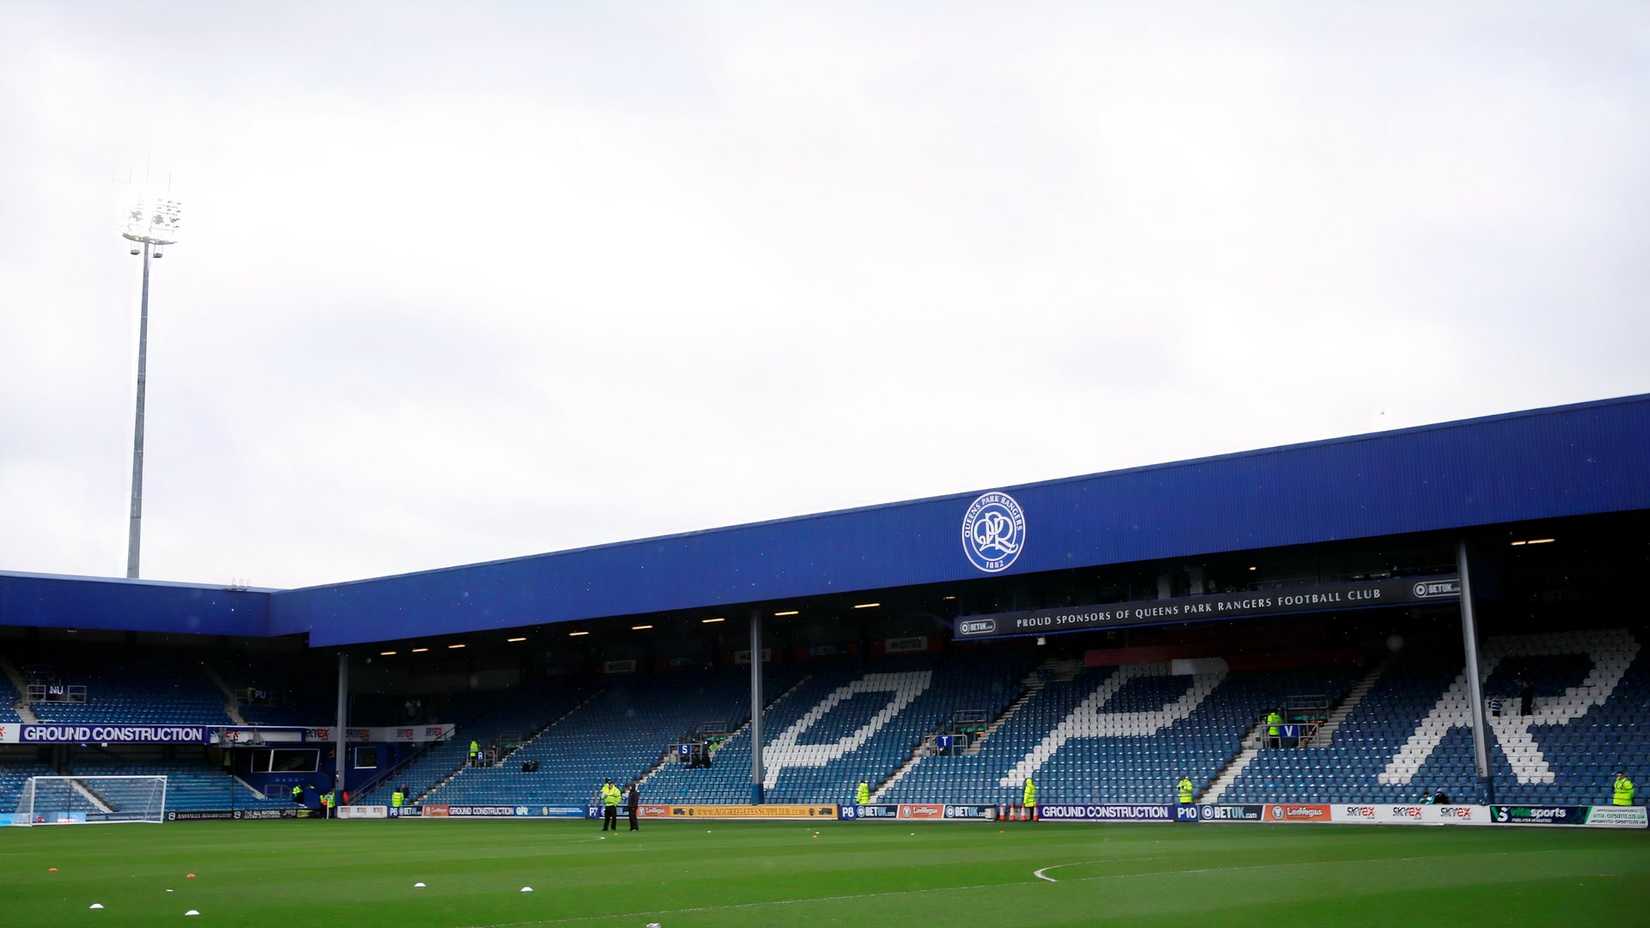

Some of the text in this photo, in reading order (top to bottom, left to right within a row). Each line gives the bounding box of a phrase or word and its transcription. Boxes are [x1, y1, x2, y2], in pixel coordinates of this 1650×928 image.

[964, 495, 1023, 538] QUEENS PARK RANGERS
[1016, 588, 1381, 628] PROUD SPONSORS OF QUEENS PARK RANGERS FOOTBALL CLUB
[49, 685, 64, 695] NU
[23, 726, 91, 741] GROUND
[92, 726, 203, 742] CONSTRUCTION
[1284, 725, 1293, 737] V
[942, 736, 948, 746] T
[682, 745, 688, 754] S
[449, 806, 472, 816] GROUND
[473, 806, 514, 816] CONSTRUCTION
[589, 807, 598, 817] P7
[842, 807, 854, 817] P8
[1042, 806, 1168, 818] GROUND CONSTRUCTION
[1177, 807, 1197, 819] P10
